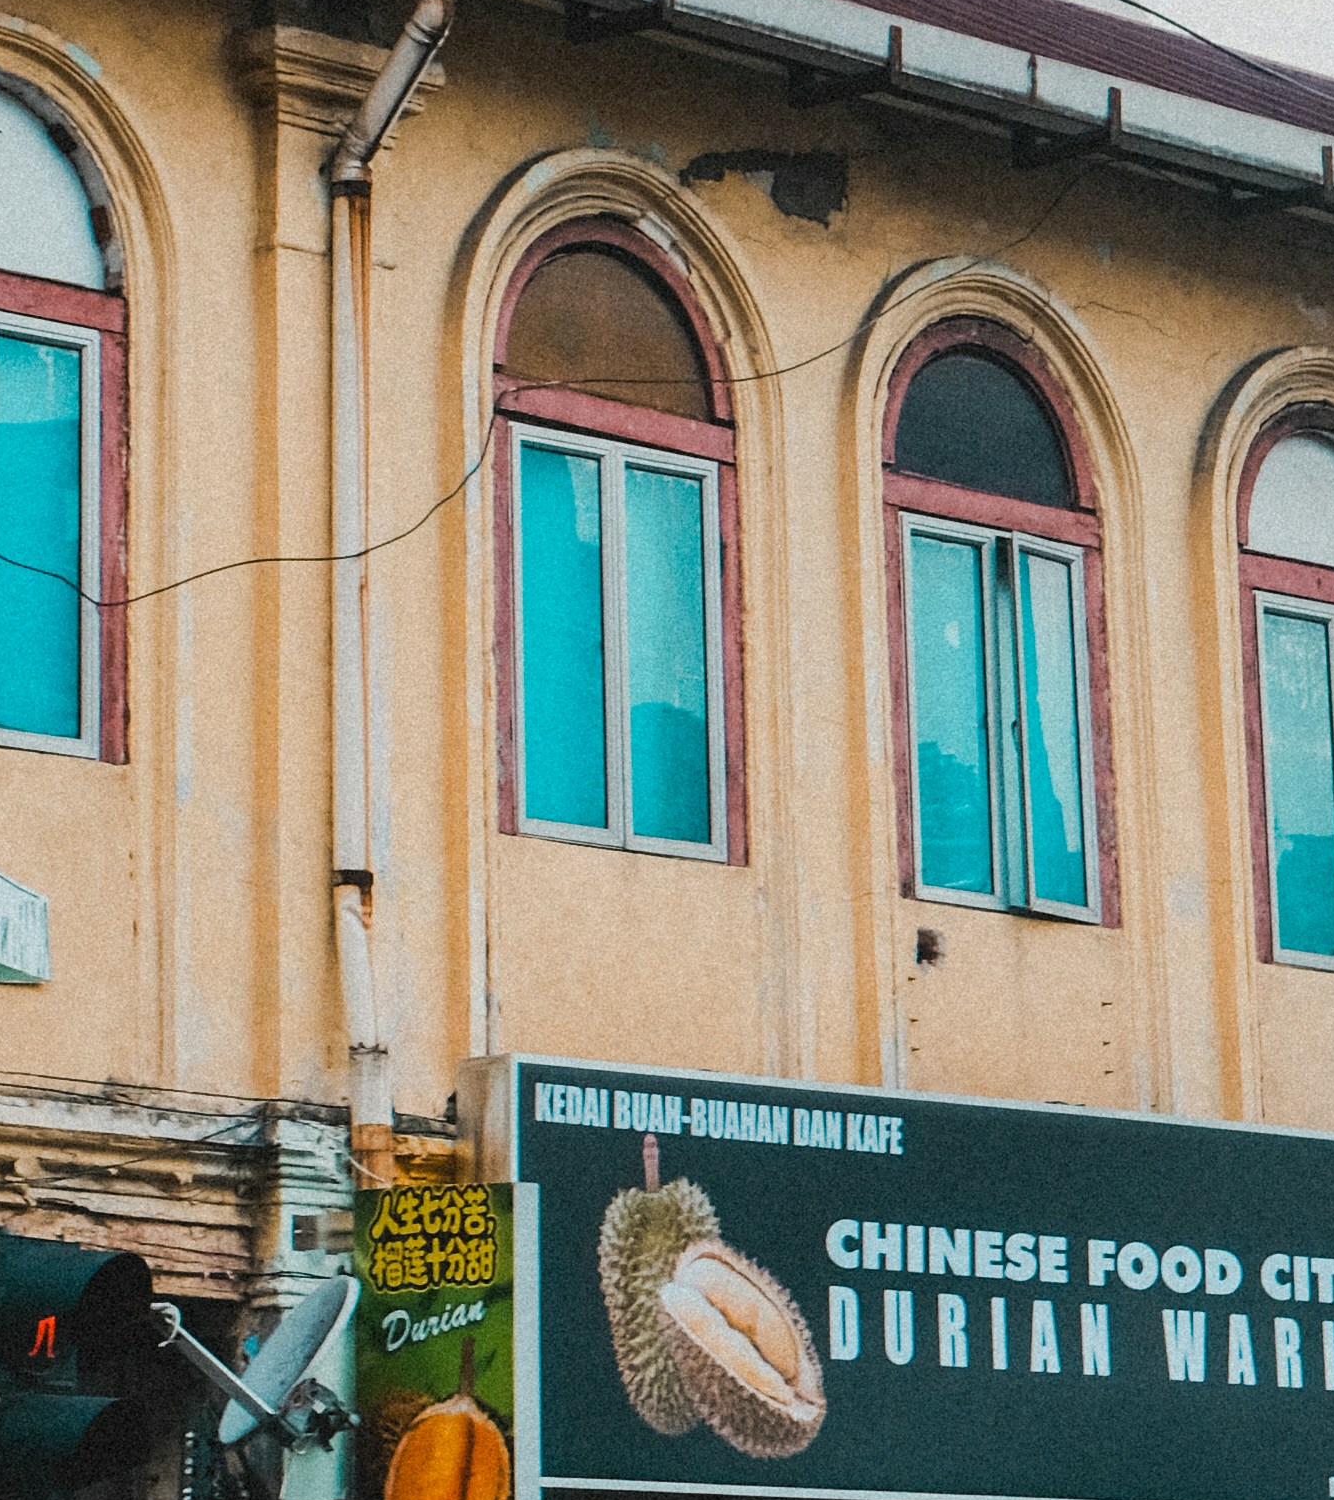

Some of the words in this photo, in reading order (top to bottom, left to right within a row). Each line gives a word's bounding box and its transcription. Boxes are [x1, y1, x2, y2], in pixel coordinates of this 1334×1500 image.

[535, 1082, 609, 1126] KEDAI
[614, 1090, 789, 1146] BUAH-BUAHAN
[794, 1107, 841, 1150] DAN
[847, 1112, 903, 1155] KAFE
[826, 1219, 1068, 1284] CHINESE
[1088, 1240, 1243, 1296] FOOD
[382, 1299, 485, 1352] Durian
[829, 1286, 1111, 1377] DURIAN
